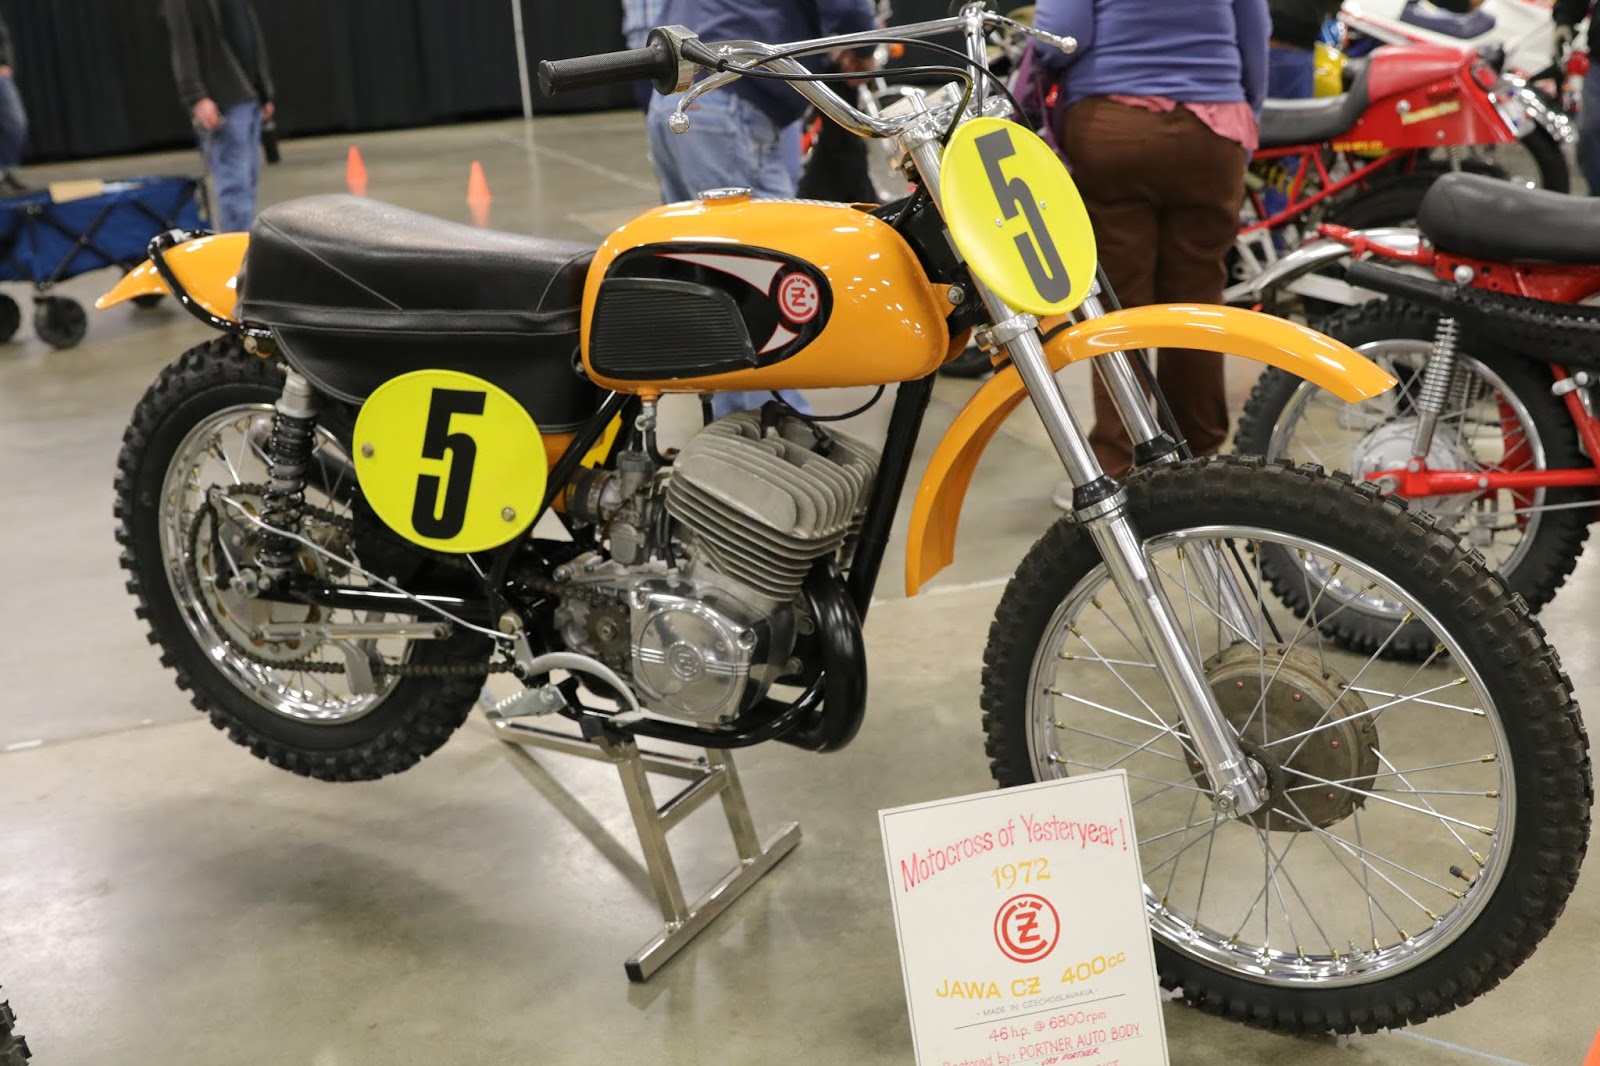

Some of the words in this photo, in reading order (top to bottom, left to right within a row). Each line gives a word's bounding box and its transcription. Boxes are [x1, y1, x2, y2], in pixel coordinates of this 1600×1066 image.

[974, 128, 1071, 304] 5
[411, 387, 487, 540] 5
[900, 830, 994, 893] Motocross
[998, 819, 1016, 848] of
[1020, 814, 1128, 852] Yesteryear!
[991, 857, 1052, 890] 1972
[936, 978, 1002, 1000] JAWA
[982, 1005, 1007, 1017] MADE
[1009, 1003, 1019, 1012] IN
[1019, 1036, 1074, 1060] PORTNER
[1076, 1029, 1107, 1049] AUTO
[1110, 1022, 1141, 1041] BODY
[1061, 1047, 1100, 1061] PORTNER
